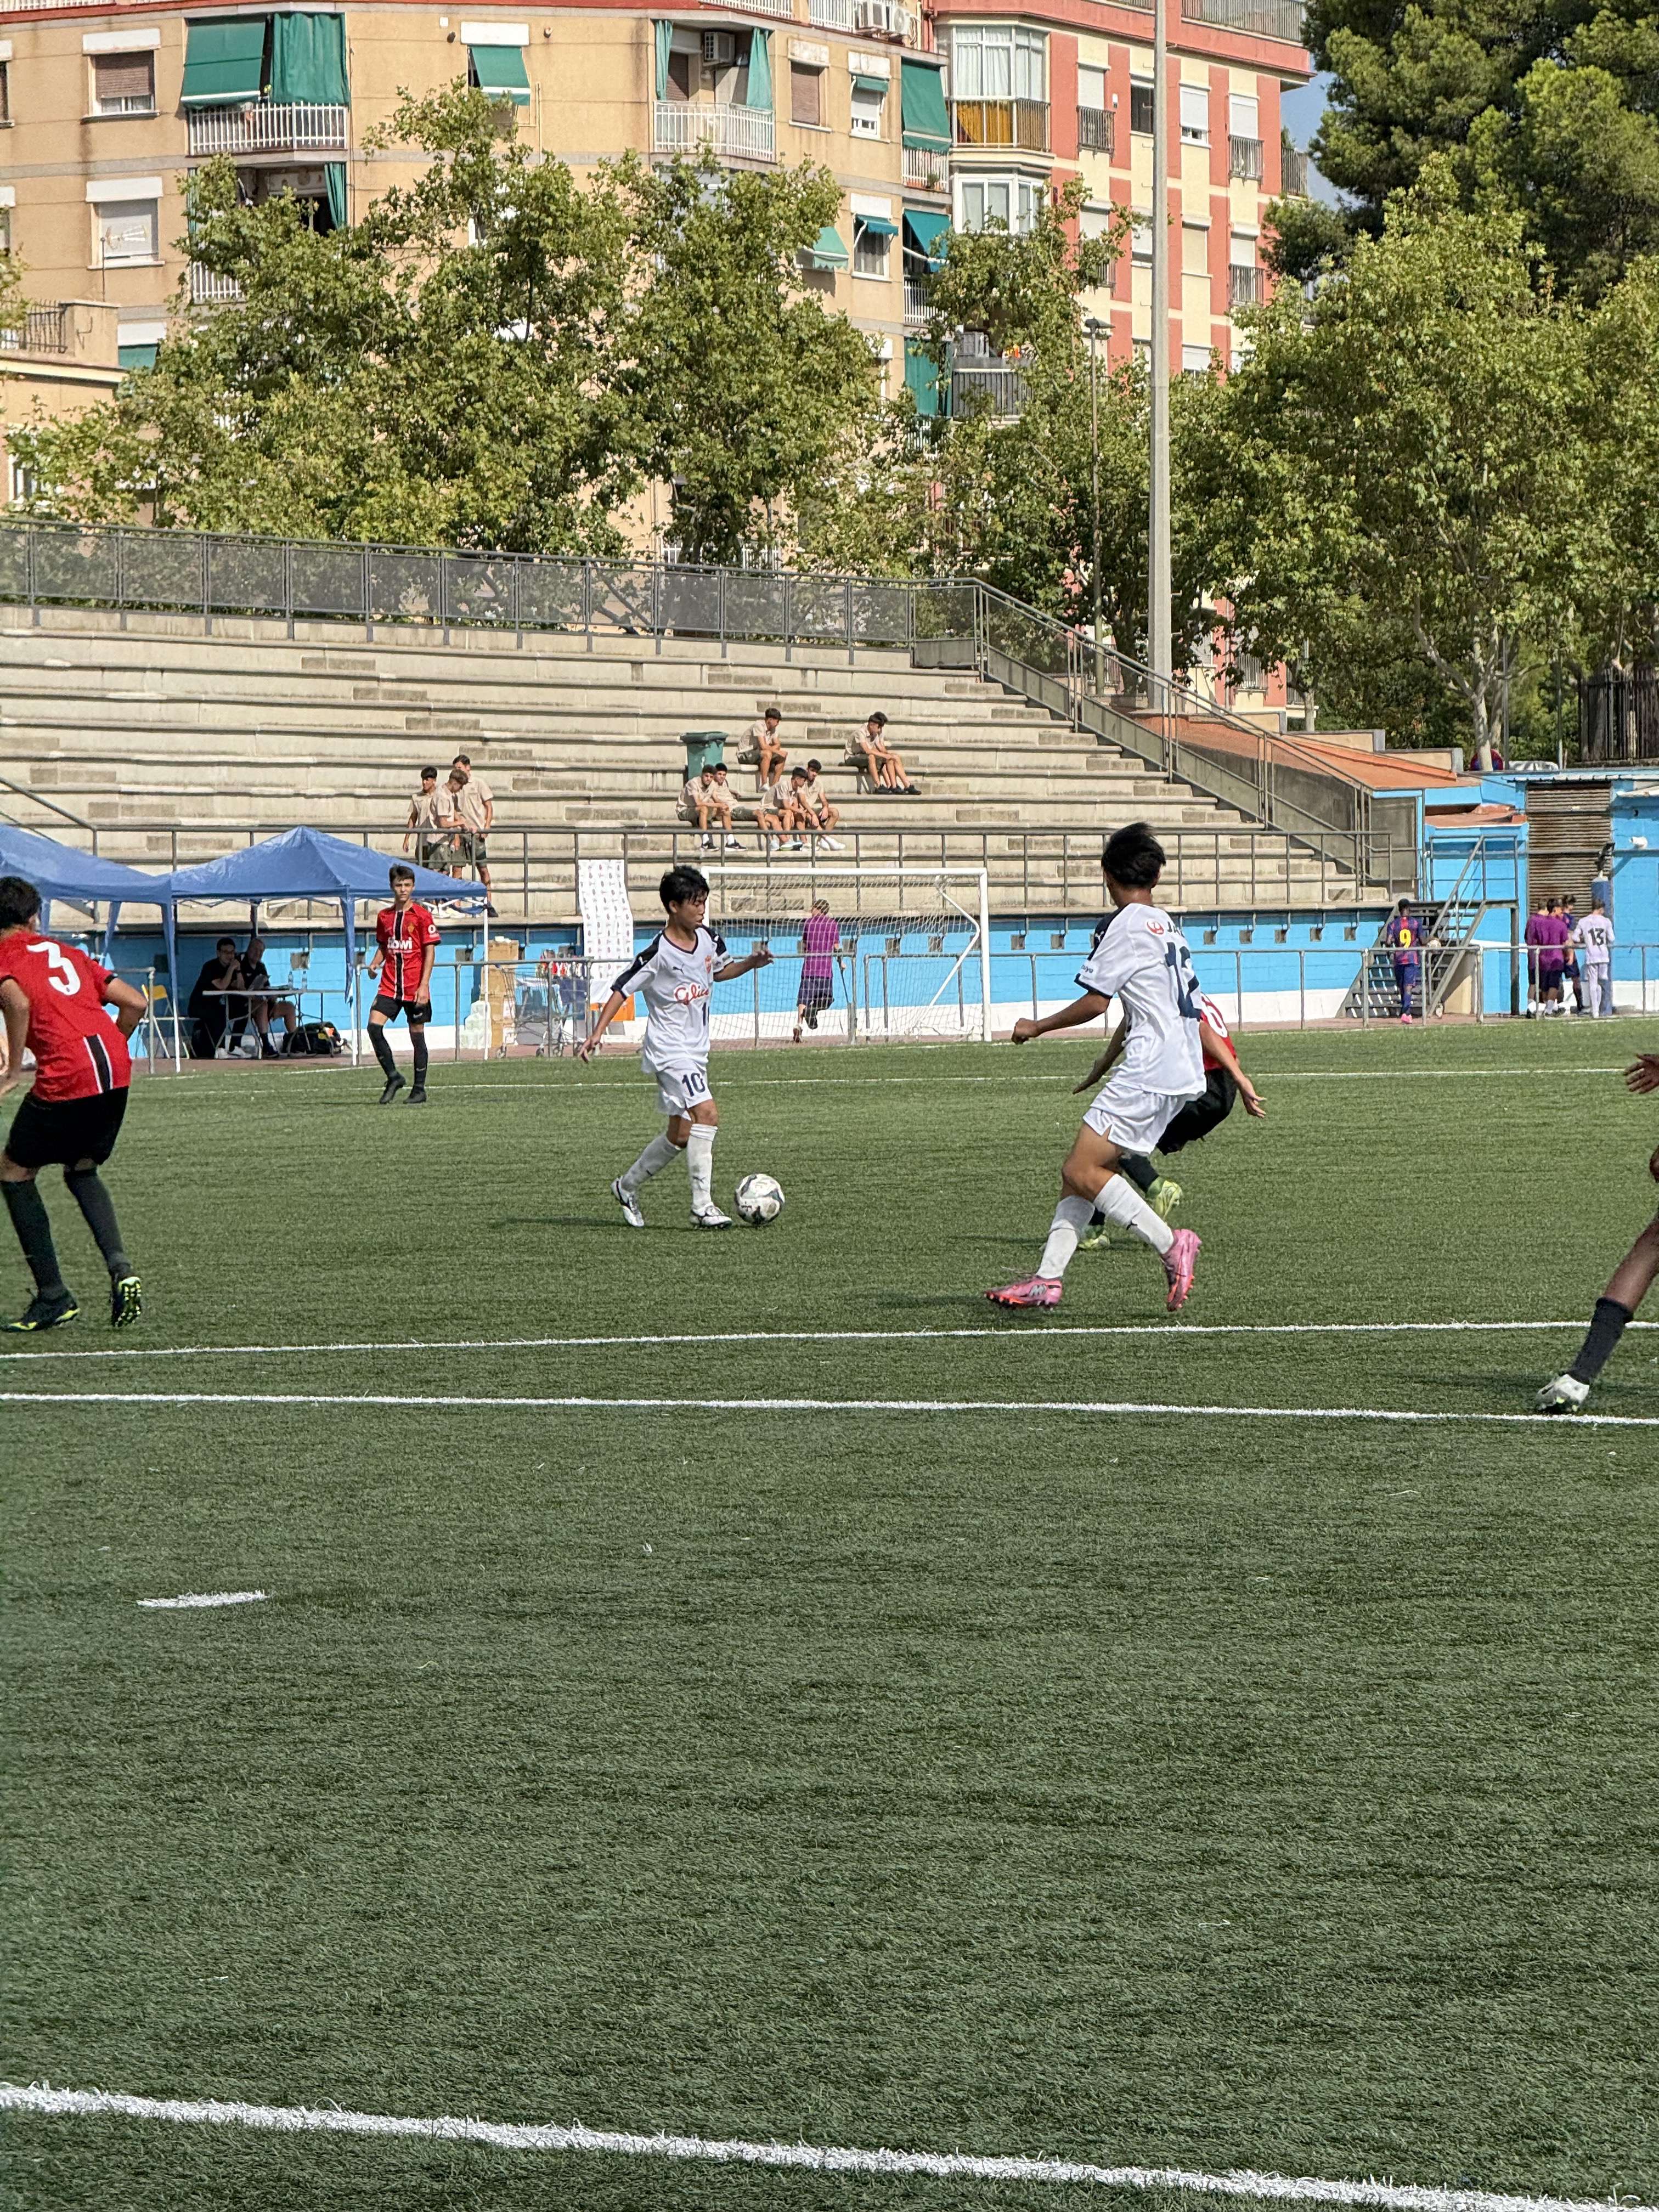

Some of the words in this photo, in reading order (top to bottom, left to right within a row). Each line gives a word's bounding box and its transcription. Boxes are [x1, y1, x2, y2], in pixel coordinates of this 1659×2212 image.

[1400, 929, 1412, 948] 9
[1588, 927, 1604, 946] 13
[26, 941, 81, 996] 3
[1165, 941, 1202, 1022] 12
[682, 1072, 706, 1097] 10
